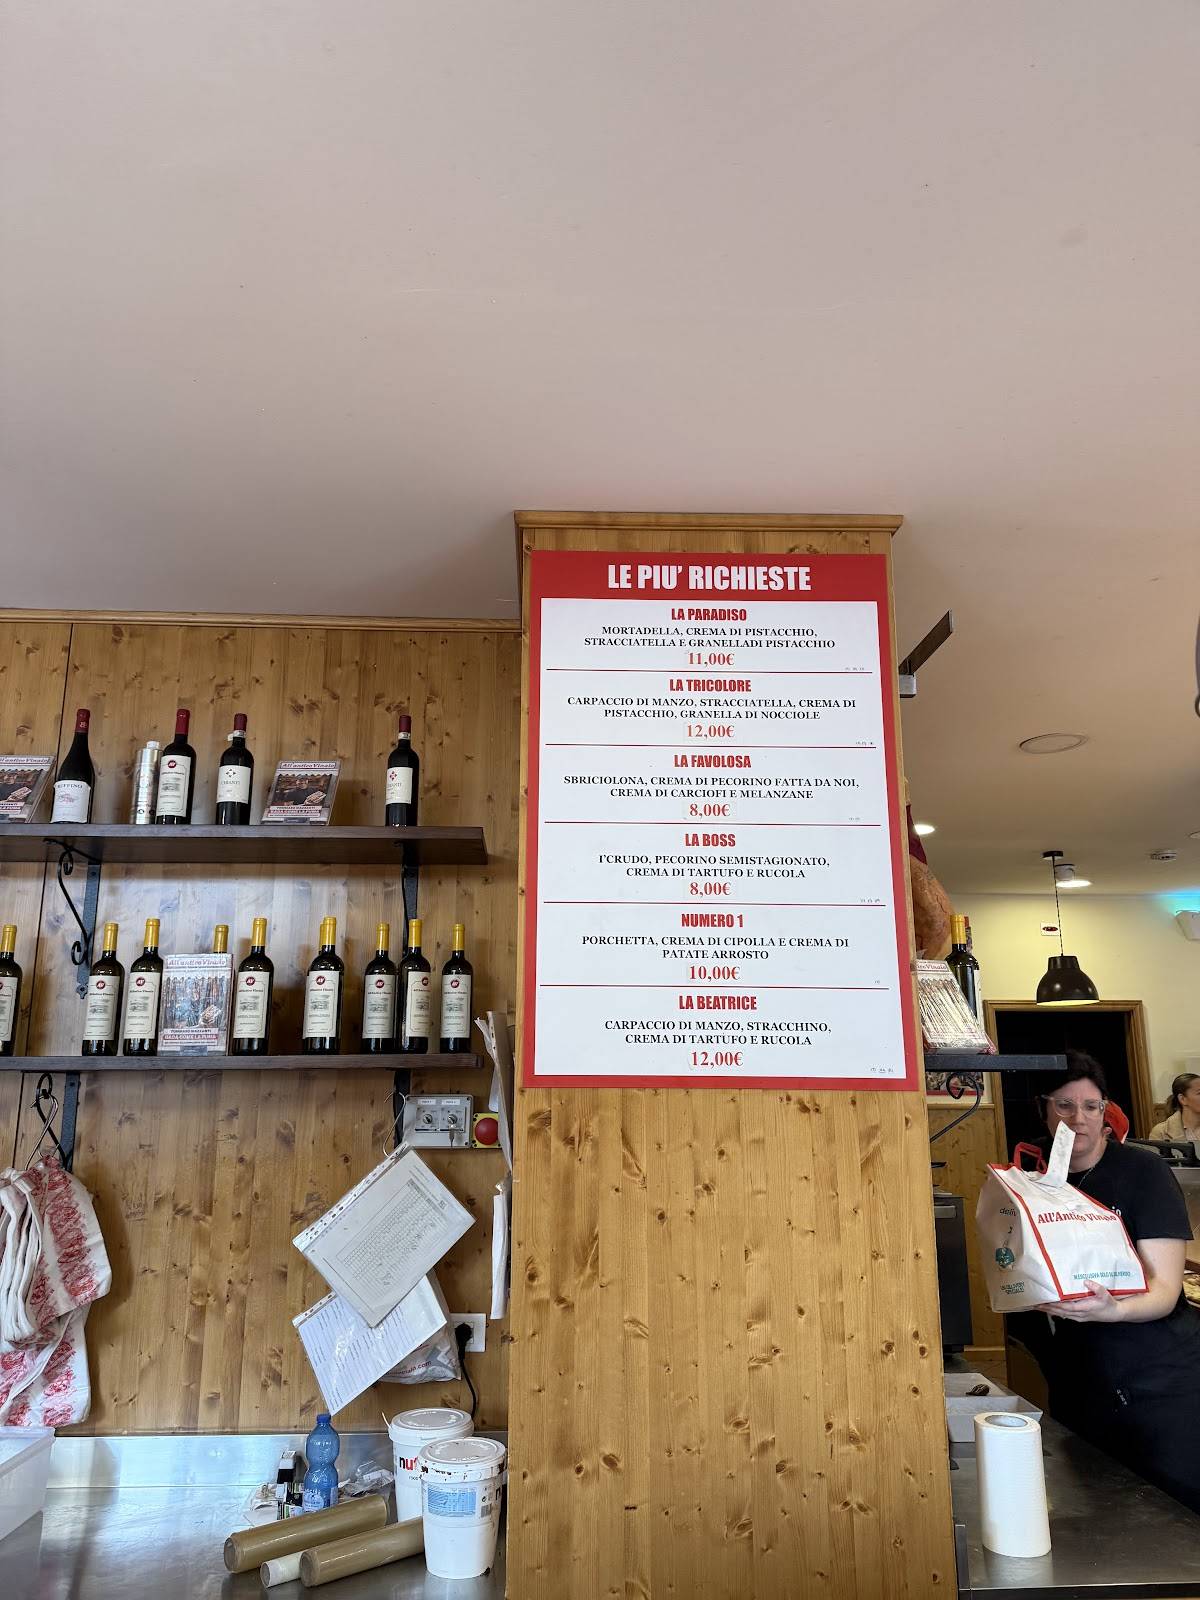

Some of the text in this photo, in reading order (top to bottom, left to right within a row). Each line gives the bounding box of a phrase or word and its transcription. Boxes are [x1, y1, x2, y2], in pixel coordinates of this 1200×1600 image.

[609, 565, 811, 590] LE PIU' RICHIESTE
[672, 608, 747, 621] LA PARADISO
[602, 627, 683, 636] MORTADELLA,
[585, 638, 676, 646] STRACCIATELLA
[766, 640, 835, 648] PISTACCHIO
[690, 653, 734, 667] 11,00€
[670, 679, 751, 692] LA TRICOLORE
[568, 697, 633, 705] CARPACCIO
[700, 699, 795, 707] STRACCIATELLA,
[605, 710, 678, 719] PISTACCHIO,
[761, 711, 820, 719] NOCCIOLE
[688, 725, 734, 739] 12,00€
[675, 755, 751, 768] LA FAVOLOSA
[564, 776, 647, 785] SBRICIOLONA,
[651, 777, 692, 785] CREMA
[712, 778, 771, 786] PECORINO
[834, 779, 859, 788] NOI,
[671, 789, 726, 797] CARCIOFI
[740, 790, 813, 798] MELANZANE
[690, 804, 730, 817] 8,00€
[685, 834, 735, 847] LA BOSS
[655, 856, 716, 864] PECORINO
[720, 857, 829, 865] SEMISTAGIONATO,
[627, 868, 669, 876] CREMA
[688, 869, 743, 877] TARTUFO
[747, 869, 753, 877] E
[690, 882, 729, 897] 8,00€
[682, 914, 743, 927] NUMERO 1
[583, 936, 848, 947] PORCHETTA, CREMA DI CIPOLLA E CREMA DI
[663, 950, 768, 959] PATATE ARROSTO
[690, 966, 740, 983] 10,00€
[679, 996, 757, 1010] LA BEATRICE
[605, 1021, 831, 1033] CARPACCIO DI MANZO, STRACCHINO,
[626, 1035, 812, 1045] CREMA DI TARTUFO E RUCOLA
[692, 1052, 743, 1067] 12,00€
